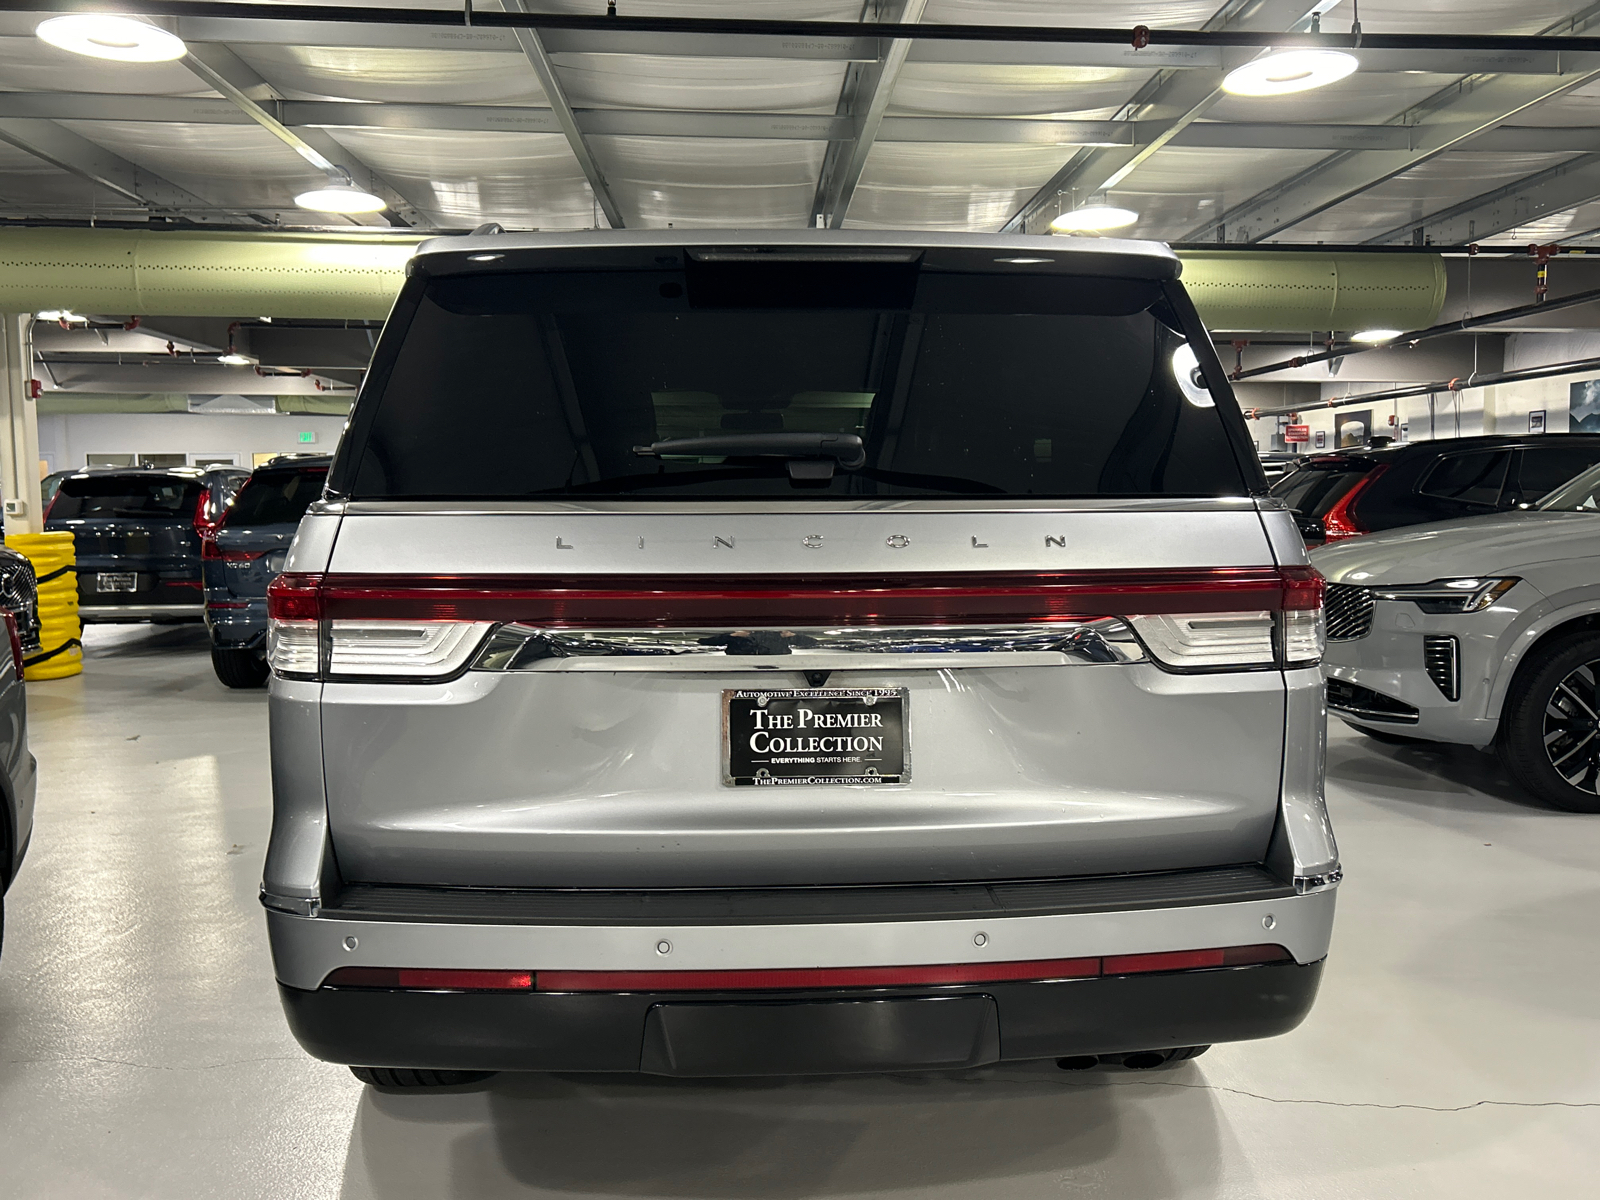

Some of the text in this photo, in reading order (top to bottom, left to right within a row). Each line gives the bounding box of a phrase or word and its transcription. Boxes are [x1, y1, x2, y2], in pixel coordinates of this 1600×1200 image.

[555, 534, 1066, 550] LINCOLN
[750, 708, 883, 730] THE PREMIER
[750, 732, 883, 753] COLLECTION
